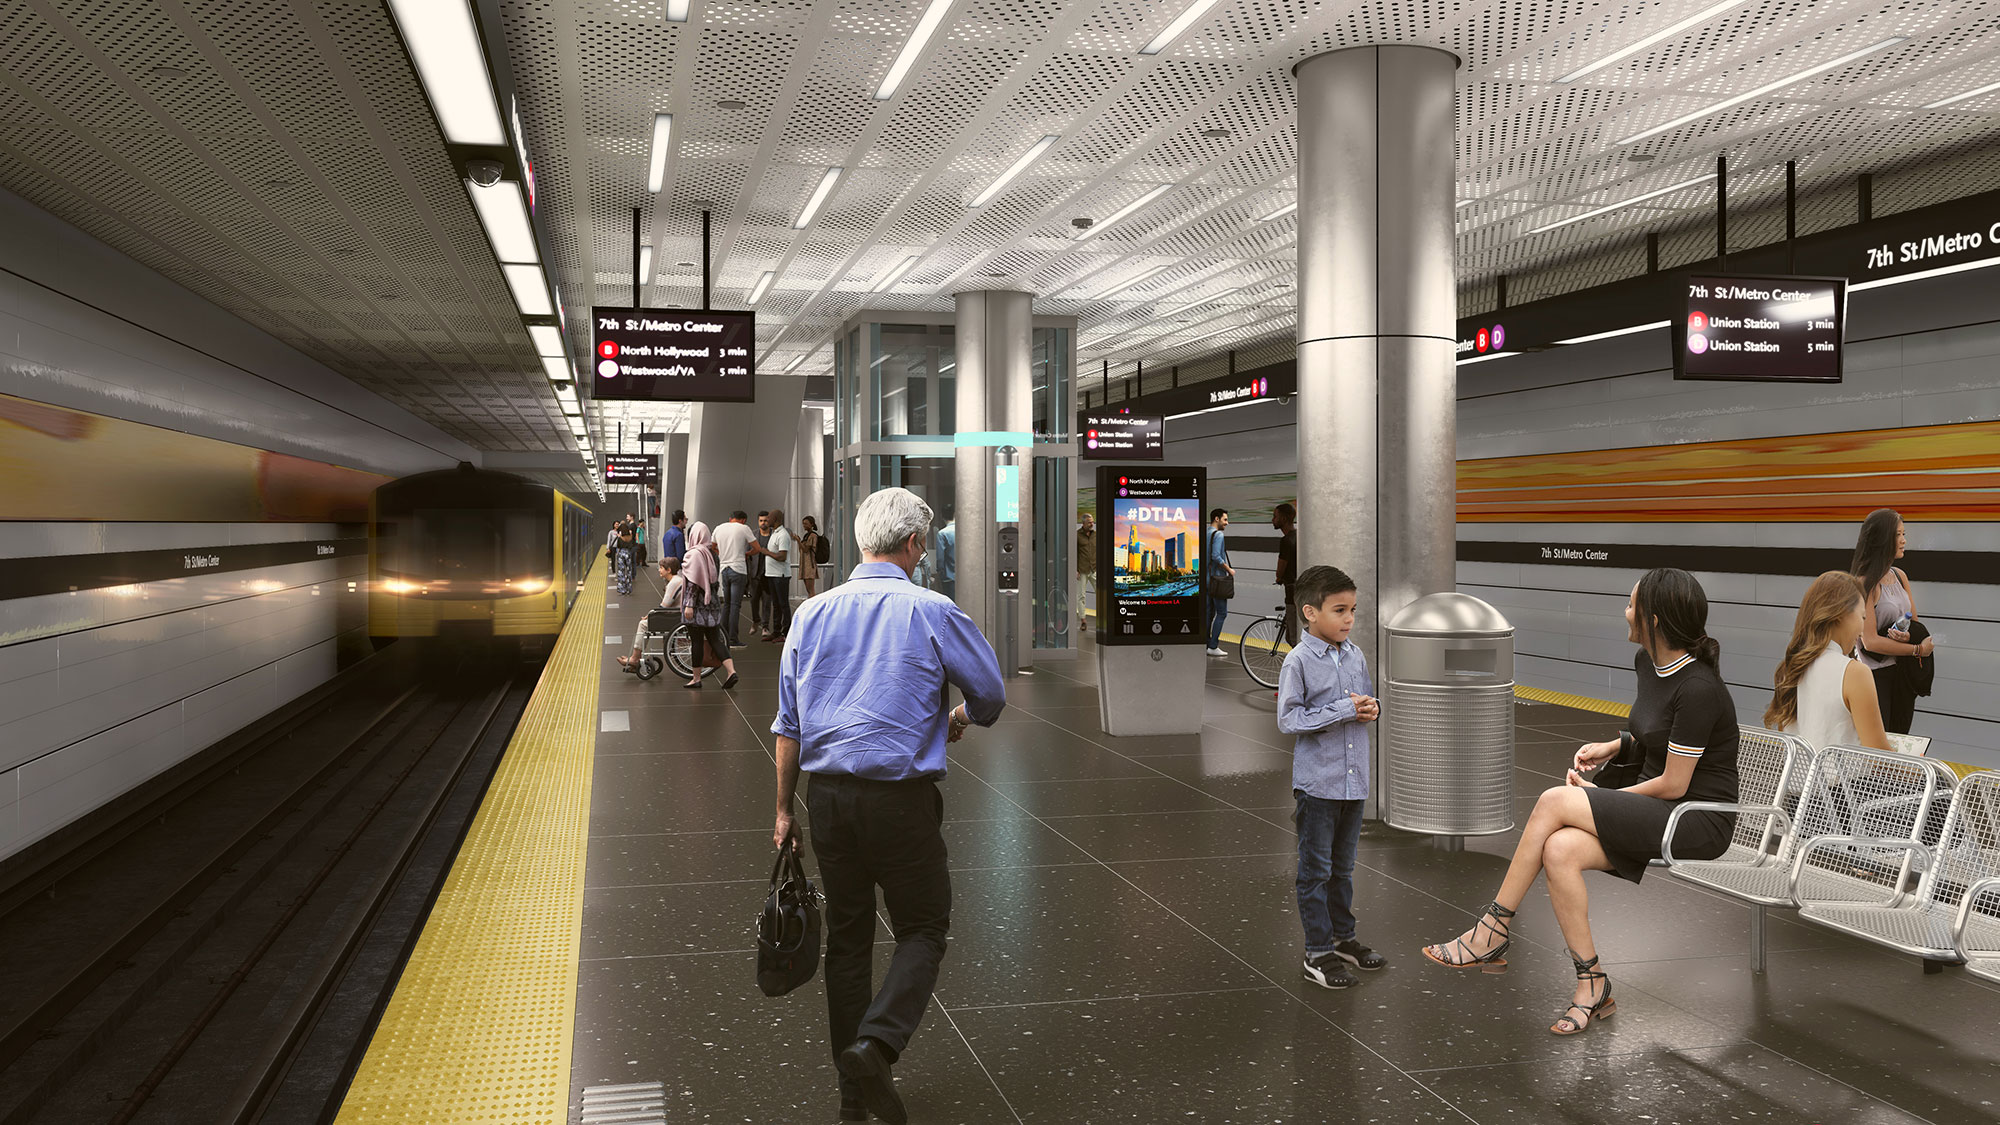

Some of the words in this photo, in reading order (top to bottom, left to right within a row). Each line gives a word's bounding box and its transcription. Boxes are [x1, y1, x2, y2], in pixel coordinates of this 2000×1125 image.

[1867, 245, 1893, 269] 7th
[1900, 233, 1983, 262] St/Metro
[1690, 285, 1708, 297] 7th
[1715, 286, 1770, 300] St/Metro
[1772, 289, 1812, 302] Center
[599, 318, 619, 329] 7th
[626, 319, 682, 331] St/Metro
[683, 321, 723, 332] Center
[1710, 317, 1741, 329] Union
[1744, 318, 1780, 329] Station
[1807, 320, 1814, 330] 3
[1816, 319, 1834, 328] min
[621, 346, 651, 355] North
[654, 346, 709, 359] Hollywood
[720, 349, 725, 357] 3
[728, 347, 747, 356] min
[1456, 339, 1475, 353] enter
[1710, 340, 1741, 351] Union
[1744, 341, 1779, 352] Station
[1808, 343, 1813, 353] 5
[1816, 341, 1834, 351] min
[620, 365, 695, 376] Westwood/VA
[720, 368, 725, 376] 5
[728, 366, 747, 375] min
[1127, 507, 1186, 522] #DTLA
[1542, 547, 1551, 558] 7th
[1554, 549, 1583, 559] St/Metro
[1585, 549, 1608, 560] Center
